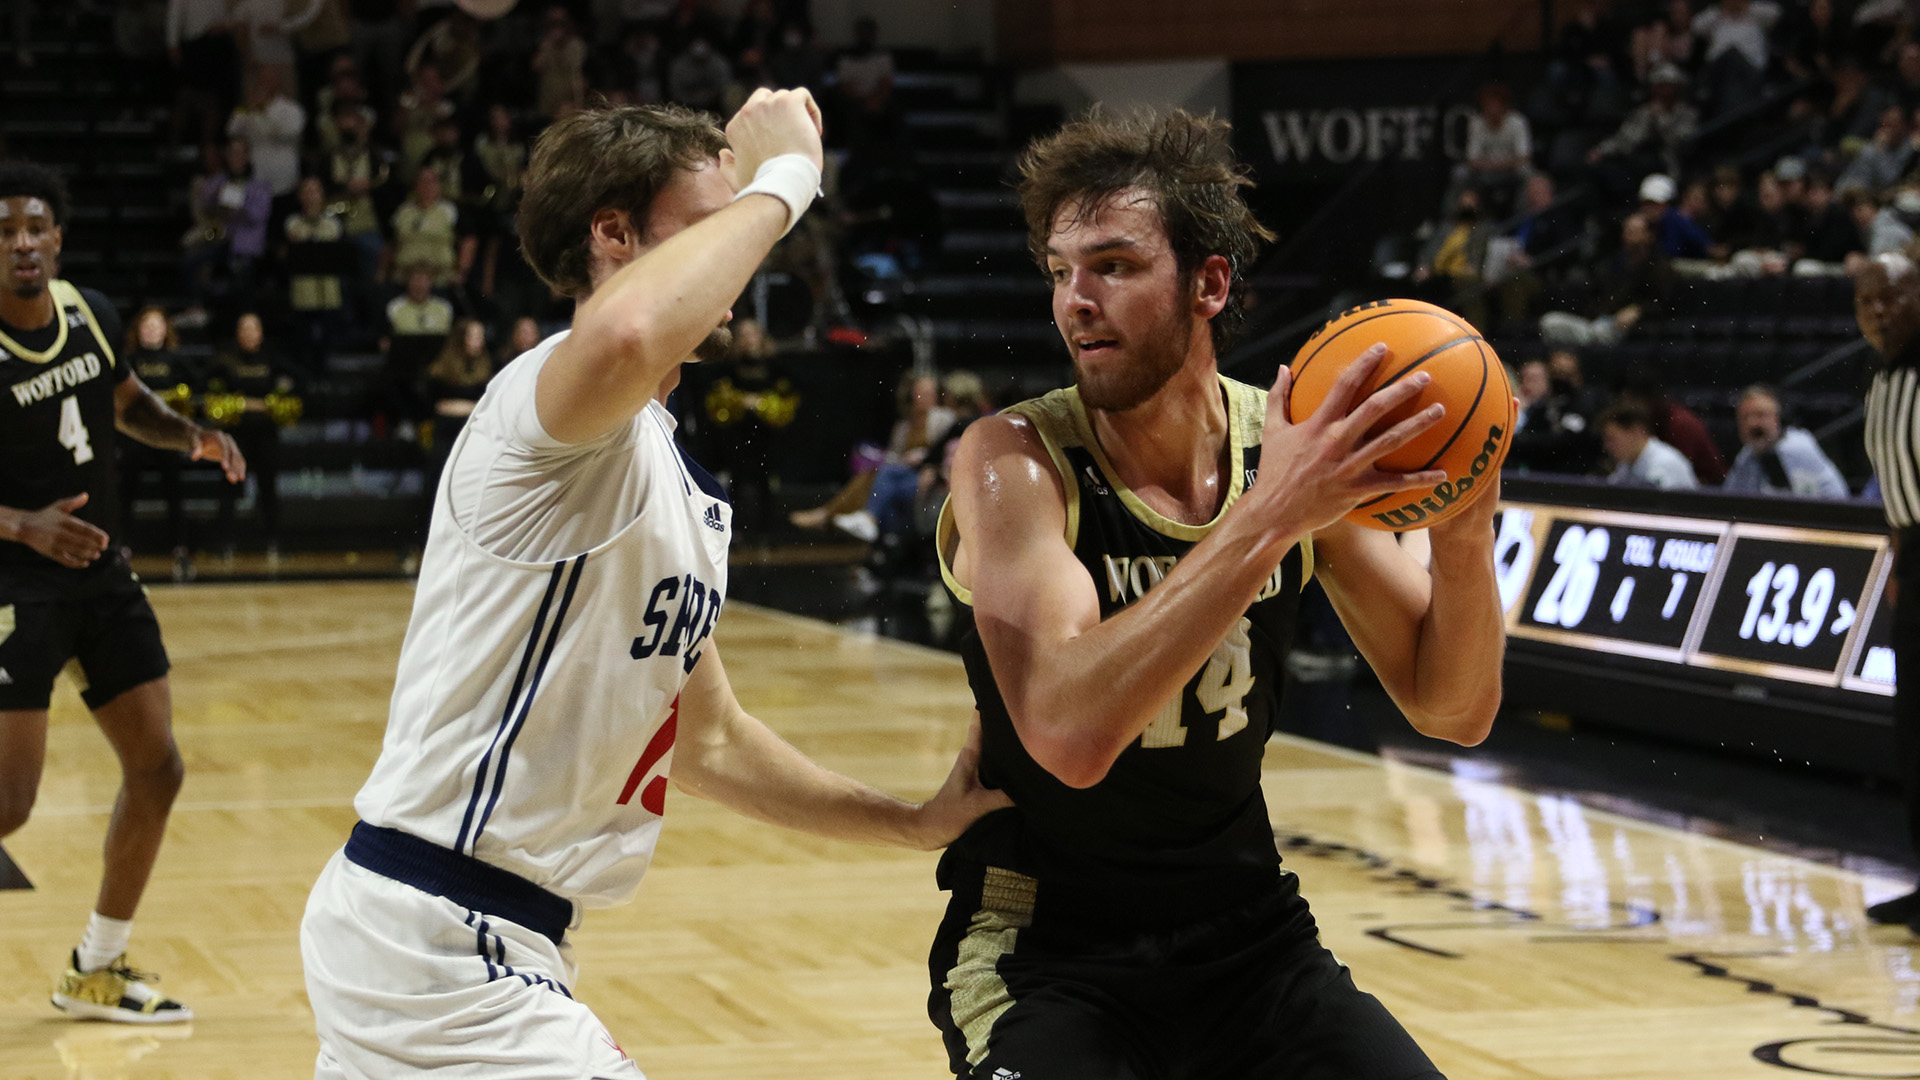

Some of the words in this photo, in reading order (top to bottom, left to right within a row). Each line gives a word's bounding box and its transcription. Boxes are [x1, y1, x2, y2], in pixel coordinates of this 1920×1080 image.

[11, 352, 101, 407] WOFFORD
[57, 394, 95, 466] 4
[1371, 421, 1506, 528] Wilson
[1532, 524, 1611, 629] 26
[1738, 560, 1836, 649] 13.9
